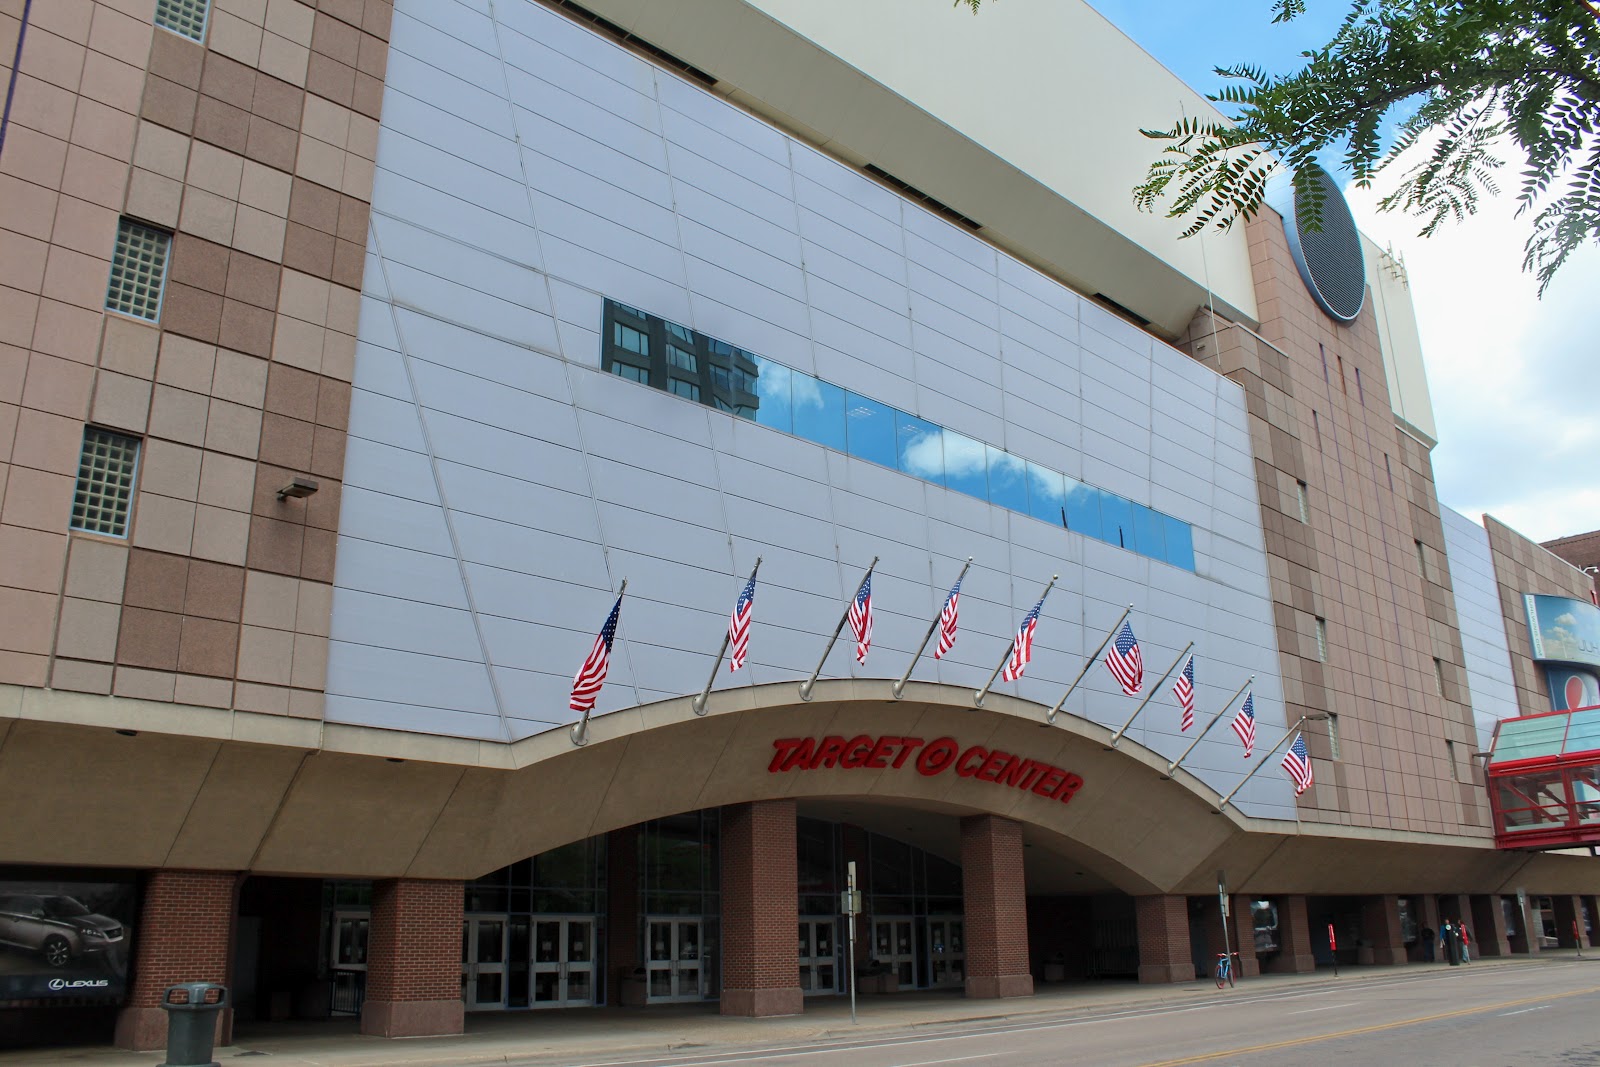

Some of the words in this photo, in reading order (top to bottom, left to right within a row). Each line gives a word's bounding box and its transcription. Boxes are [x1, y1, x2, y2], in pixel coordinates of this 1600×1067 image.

[768, 735, 925, 772] TARGET
[955, 746, 1085, 804] CENTER
[65, 980, 108, 988] LEXUS
